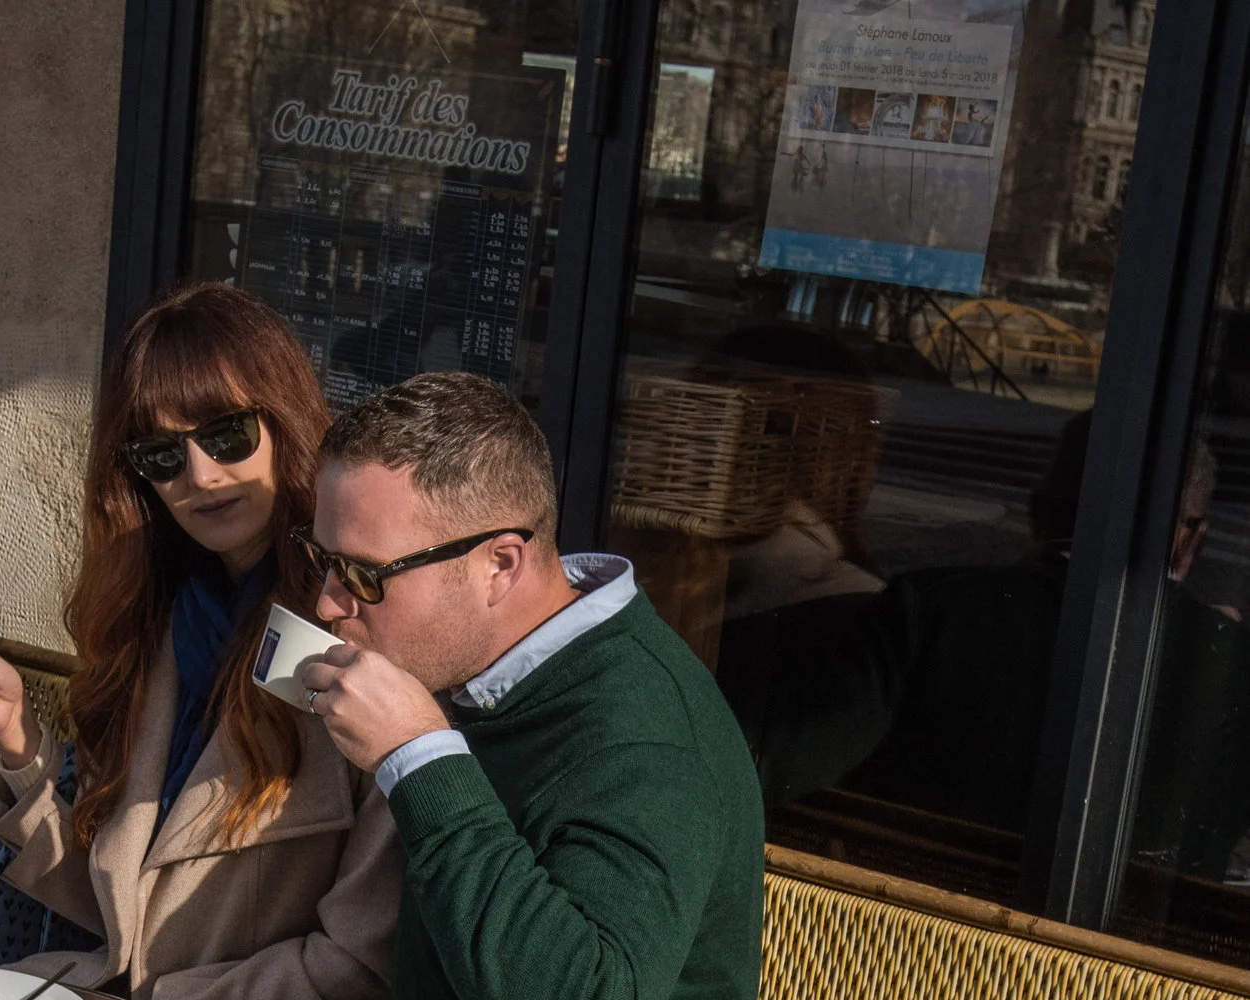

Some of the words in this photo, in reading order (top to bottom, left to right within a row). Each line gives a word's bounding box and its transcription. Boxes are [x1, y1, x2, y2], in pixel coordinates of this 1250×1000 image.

[855, 23, 908, 41] Stéphane
[912, 27, 953, 43] Lanoux
[880, 64, 903, 76] 2018
[973, 71, 998, 84] 2018
[329, 69, 416, 126] Tarif
[411, 79, 468, 127] des
[272, 101, 531, 175] Consommations
